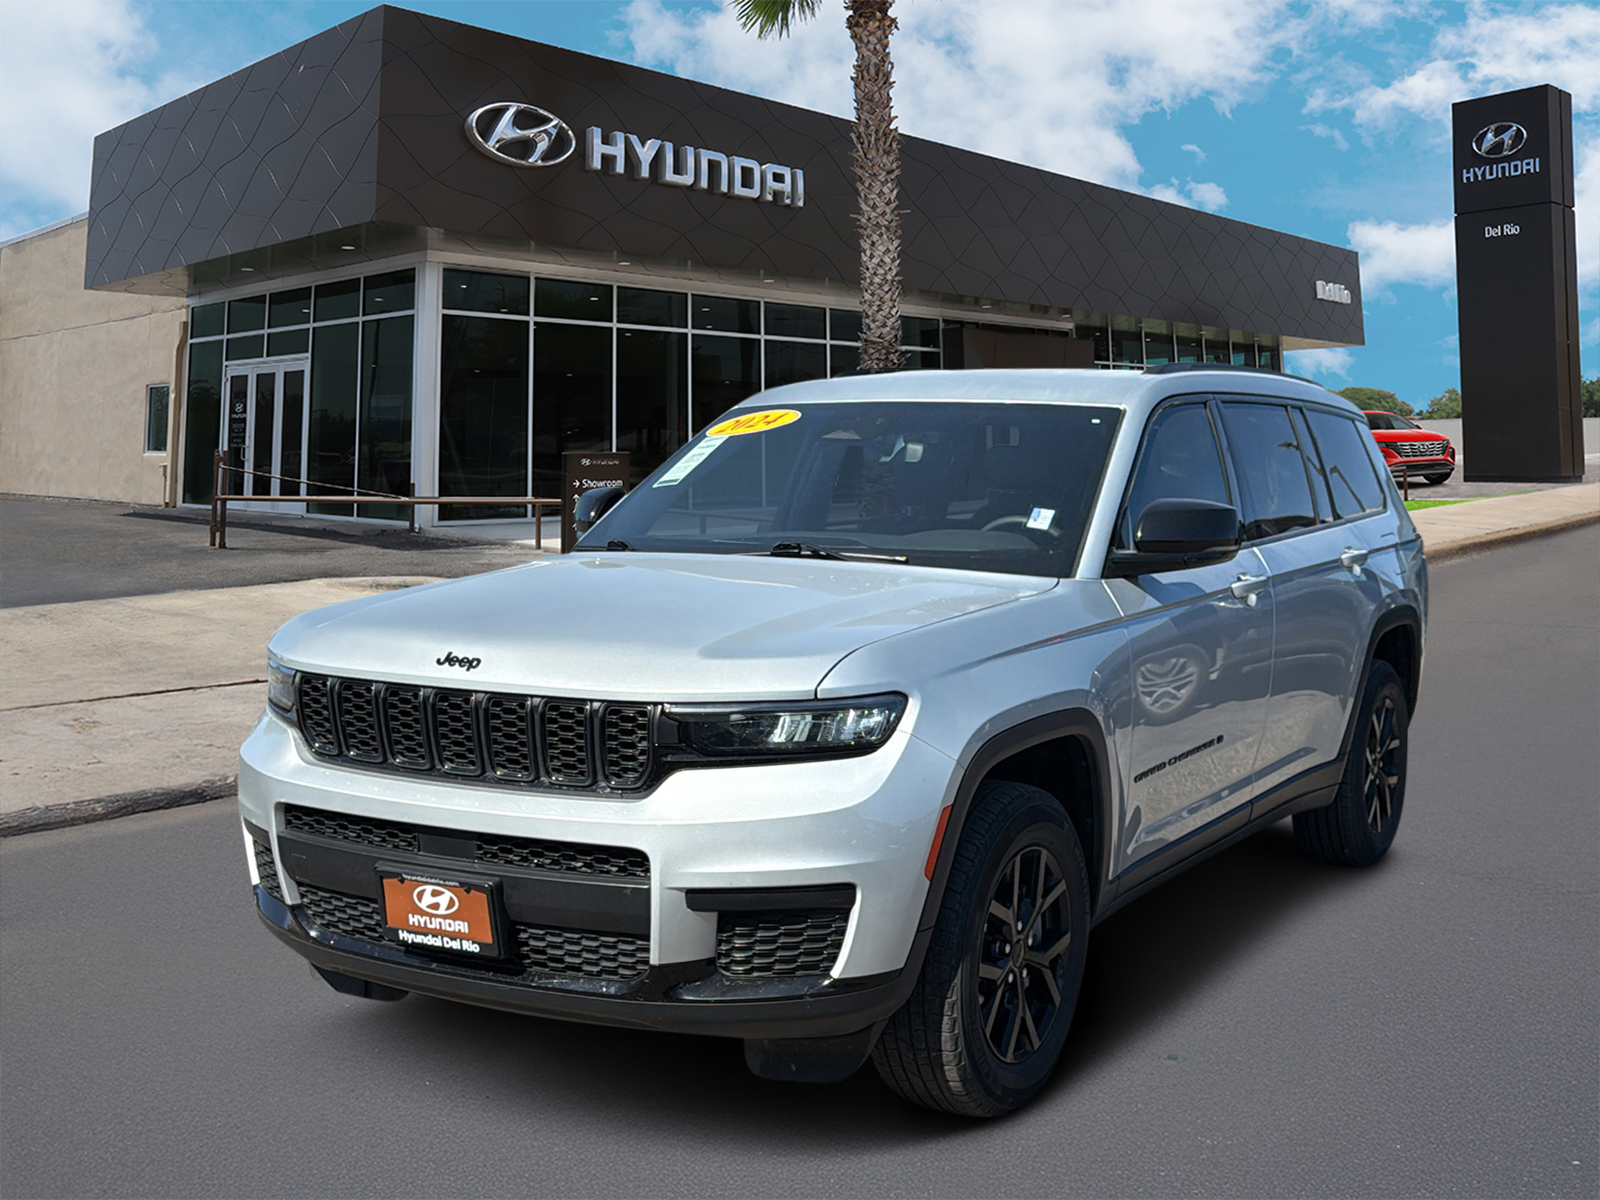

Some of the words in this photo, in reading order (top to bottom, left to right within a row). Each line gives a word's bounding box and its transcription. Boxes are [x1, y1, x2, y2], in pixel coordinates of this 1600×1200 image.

[585, 125, 804, 208] HYUNDAI
[1462, 157, 1540, 183] HYUNDAI
[1484, 225, 1501, 238] Del
[1503, 223, 1520, 236] Rio
[715, 412, 790, 434] 2024
[581, 478, 624, 489] Showroom
[435, 650, 482, 672] Jeep
[407, 913, 469, 934] HYUNDAI
[398, 929, 442, 947] Hyundai
[443, 936, 461, 950] Del
[461, 939, 481, 953] Rio
